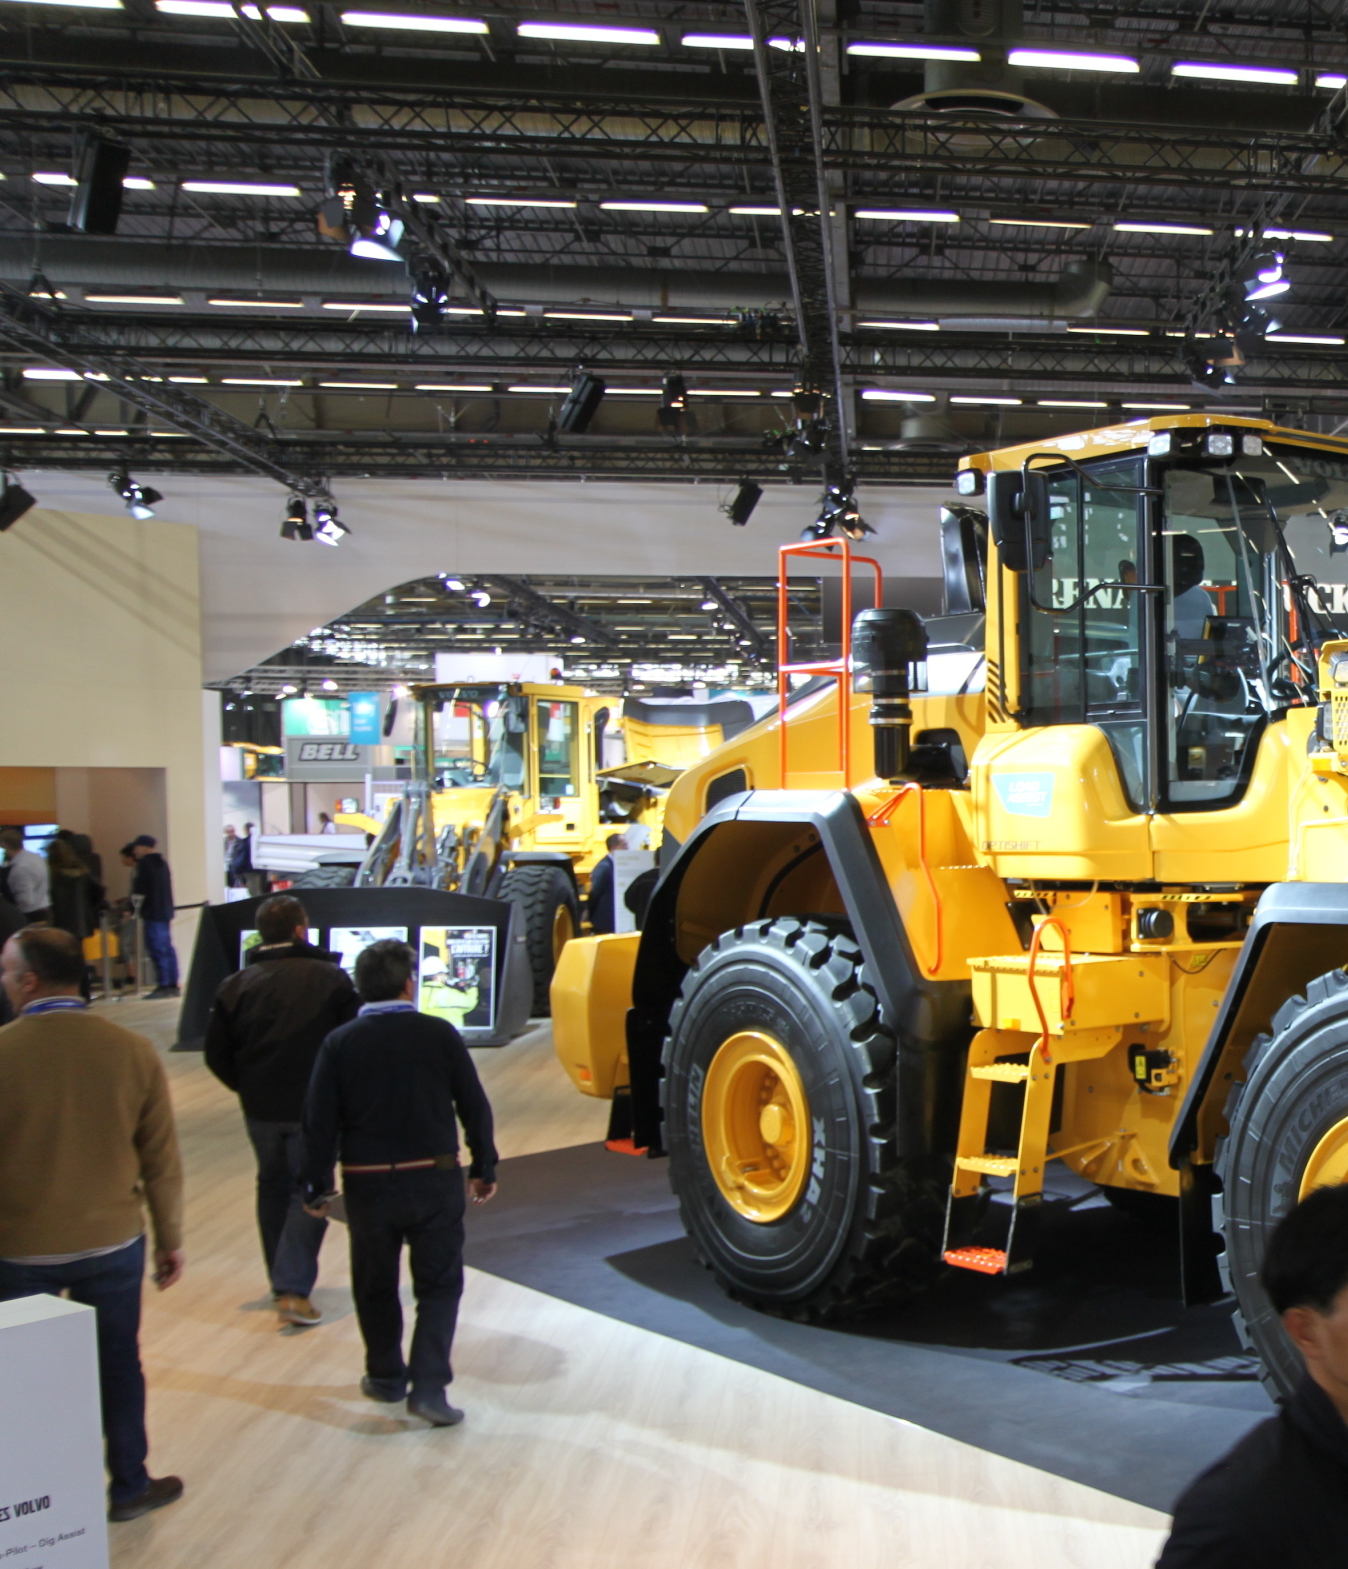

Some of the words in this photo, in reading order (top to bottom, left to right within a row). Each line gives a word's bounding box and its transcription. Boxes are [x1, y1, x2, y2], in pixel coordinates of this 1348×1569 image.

[299, 743, 358, 761] BELL
[14, 1495, 50, 1518] VOLVO
[39, 1538, 55, 1548] Dig
[57, 1528, 85, 1542] Assist
